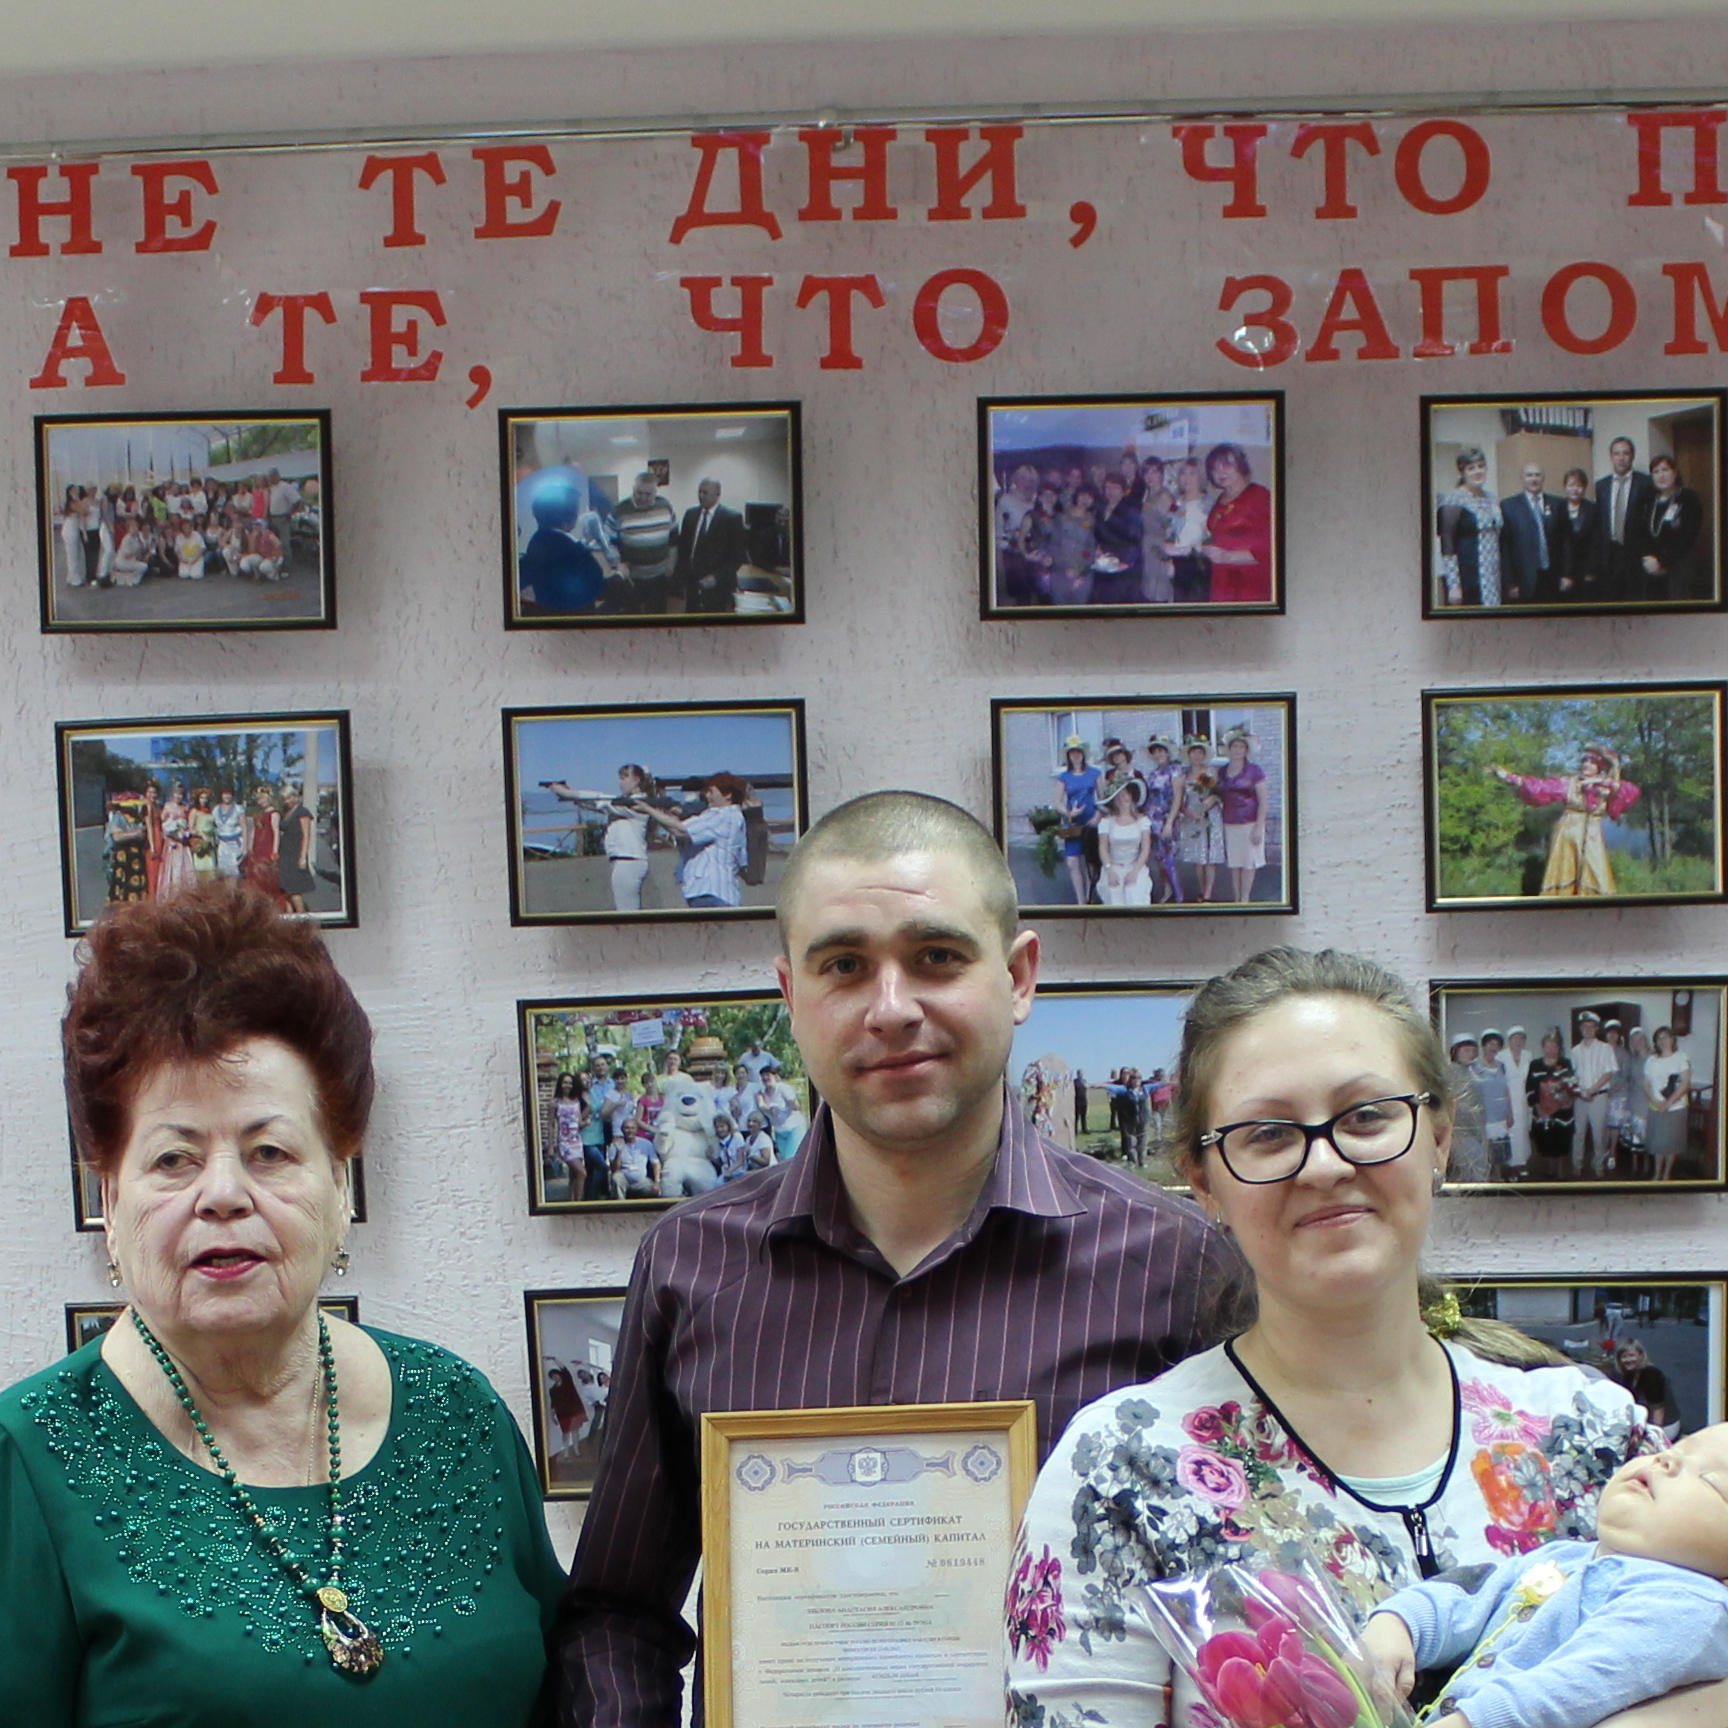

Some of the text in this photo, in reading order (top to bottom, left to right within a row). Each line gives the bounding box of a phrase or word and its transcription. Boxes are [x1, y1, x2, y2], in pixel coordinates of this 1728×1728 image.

[6, 160, 220, 258] НЕ
[359, 145, 562, 248] ТЕ
[670, 125, 1097, 247] ДНИ,
[1172, 122, 1491, 219] ЧТО
[29, 296, 127, 389] А
[250, 289, 492, 410] ТЕ,
[680, 267, 1010, 369] ЧТО
[755, 1531, 987, 1550] НА МАТЕРИНСКИЙ (СЕМЕЙНЫЙ) КАПИТАЛ
[777, 1514, 963, 1531] ГОСУДАРСТВЕННЫЙ СЕРТИФИКАТ
